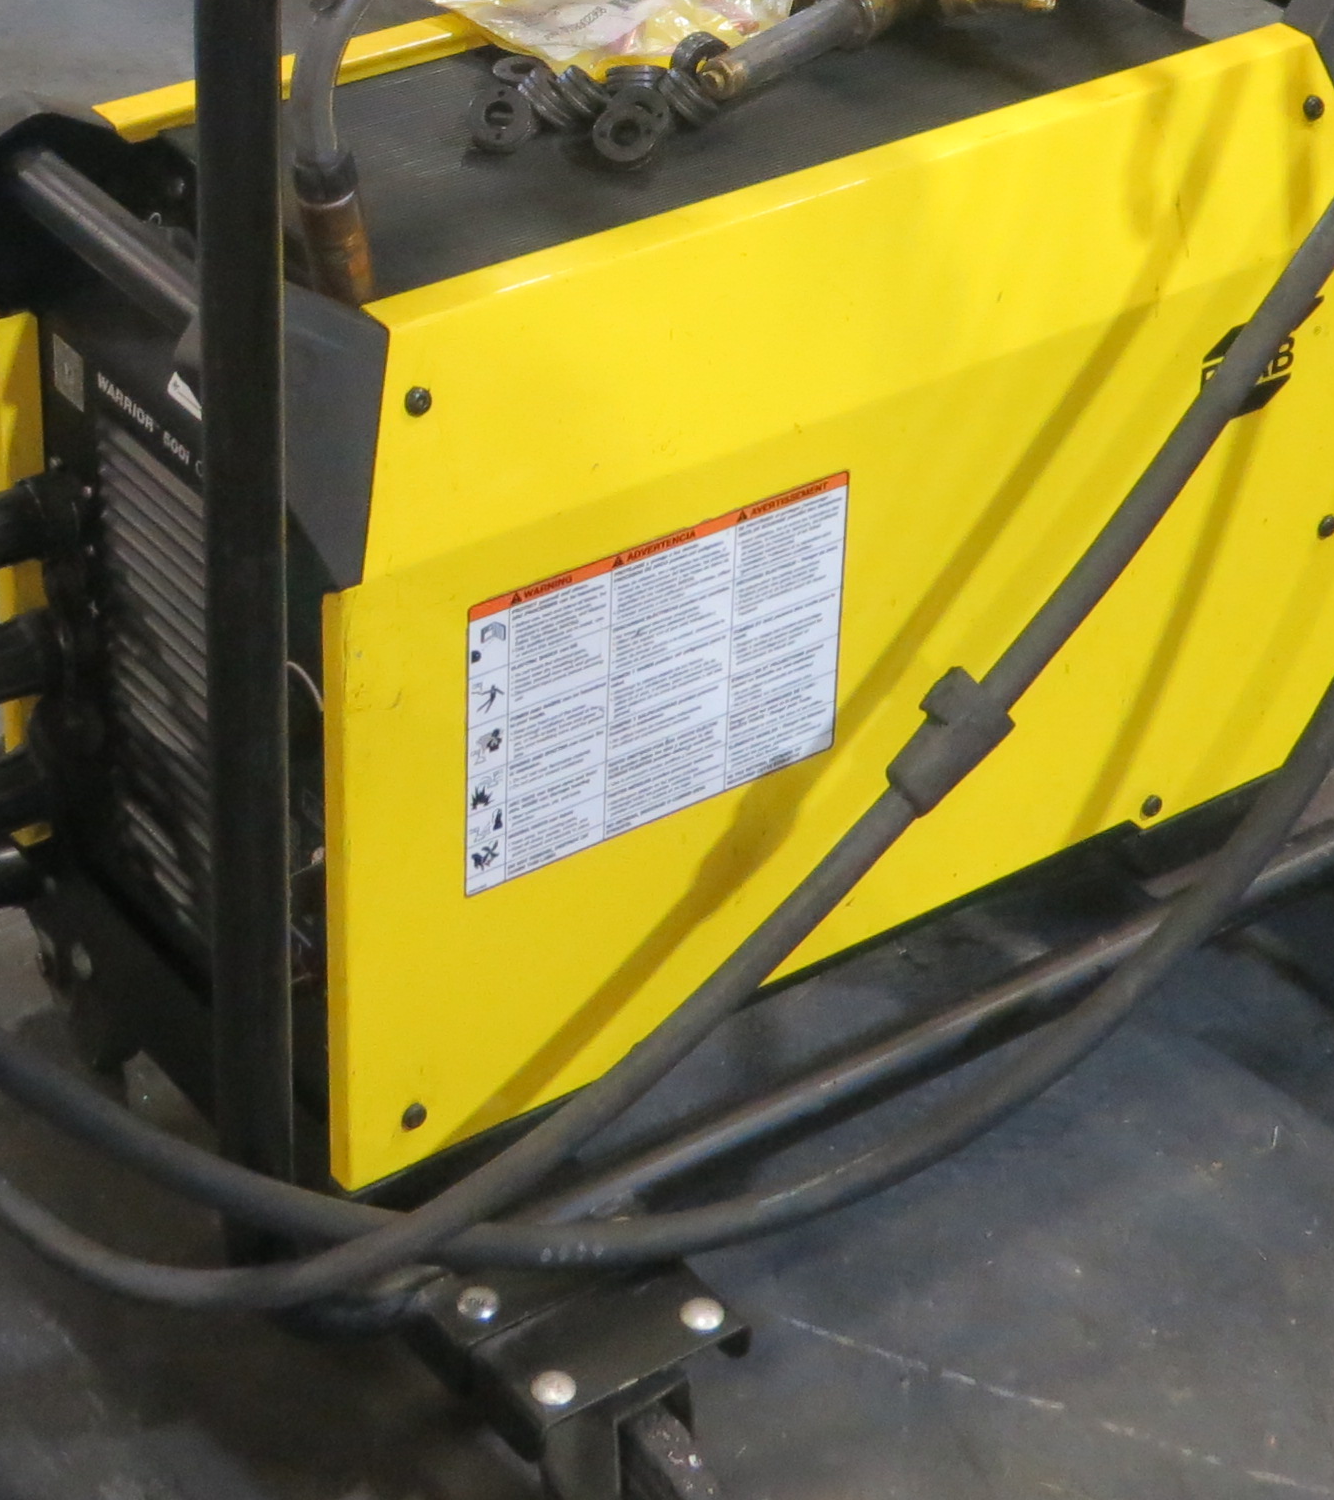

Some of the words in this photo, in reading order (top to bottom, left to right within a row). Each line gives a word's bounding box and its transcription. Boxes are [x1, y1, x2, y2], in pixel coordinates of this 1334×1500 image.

[97, 371, 154, 433] WARRIOR
[626, 529, 697, 563] ADVERTENCIA
[523, 575, 573, 601] WARNING
